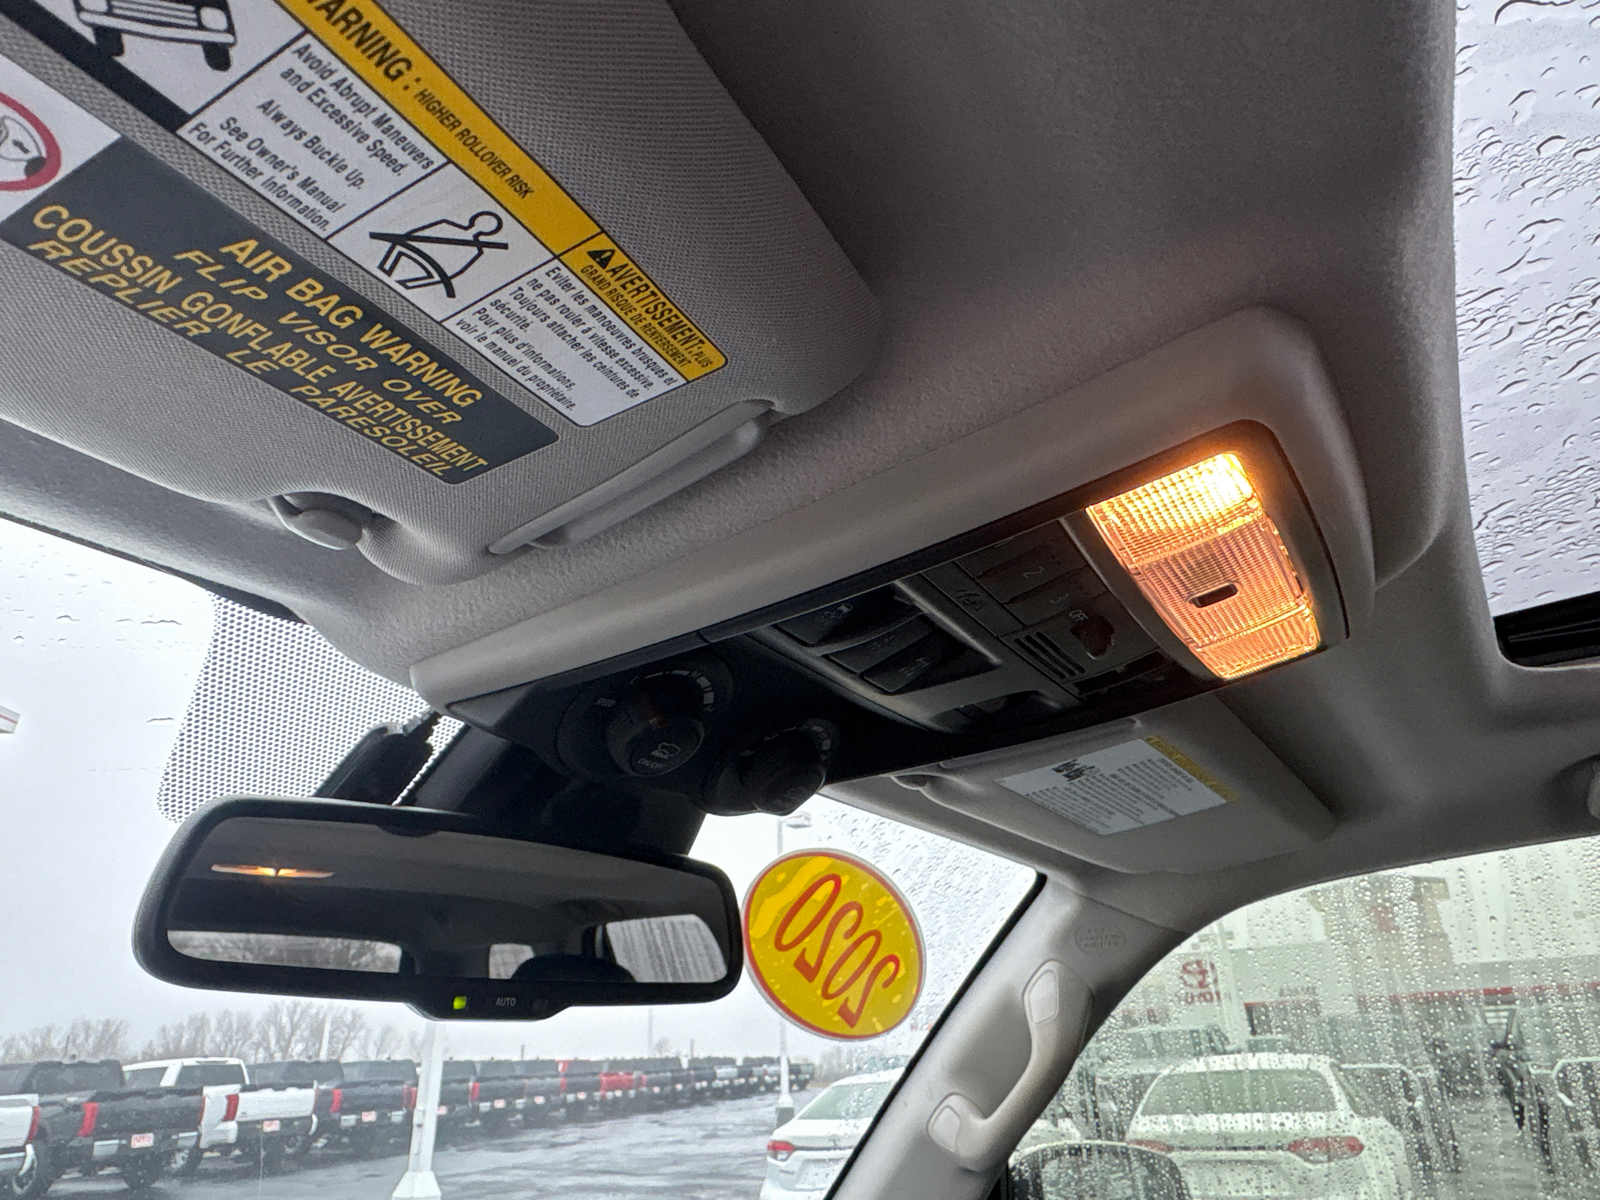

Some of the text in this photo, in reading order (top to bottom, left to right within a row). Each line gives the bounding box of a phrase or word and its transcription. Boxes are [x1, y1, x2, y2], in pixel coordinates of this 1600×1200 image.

[256, 99, 365, 190] Always Buckle Up.
[280, 68, 409, 177] and Excessive Speed.
[292, 43, 435, 170] Avoid Abrupt Maneuvers
[306, 0, 535, 199] ARNING: HIGHER ROLLOVER RISK
[188, 121, 330, 231] For Further Information.
[219, 116, 347, 214] See Owner's Manual
[27, 240, 455, 477] REPLIER LE PARESOLEIL
[33, 205, 489, 472] COUSSIN GONFLABLE AVERTISSEMENT
[173, 250, 464, 425] FLIP VISOR OVER
[219, 239, 483, 408] AIR BAG WARNING
[455, 318, 576, 411] voir le manuel du propriétaire.
[472, 307, 499, 328] Pour
[491, 326, 519, 345] plus
[490, 299, 535, 333] sécurité.
[509, 286, 640, 399] Toujours attacher les ceintures de
[526, 278, 543, 291] ne
[536, 288, 561, 306] pas
[555, 304, 587, 329] rouler
[588, 332, 620, 359] vitesse
[615, 356, 654, 391] excessive.
[545, 266, 679, 386] Eviter les manoeuvres brusques et
[580, 264, 692, 368] GRAND RISQUE DE RENVERSEMENT
[606, 263, 713, 368] AVERTISSEMENT: PLUS
[495, 997, 516, 1007] AUTO
